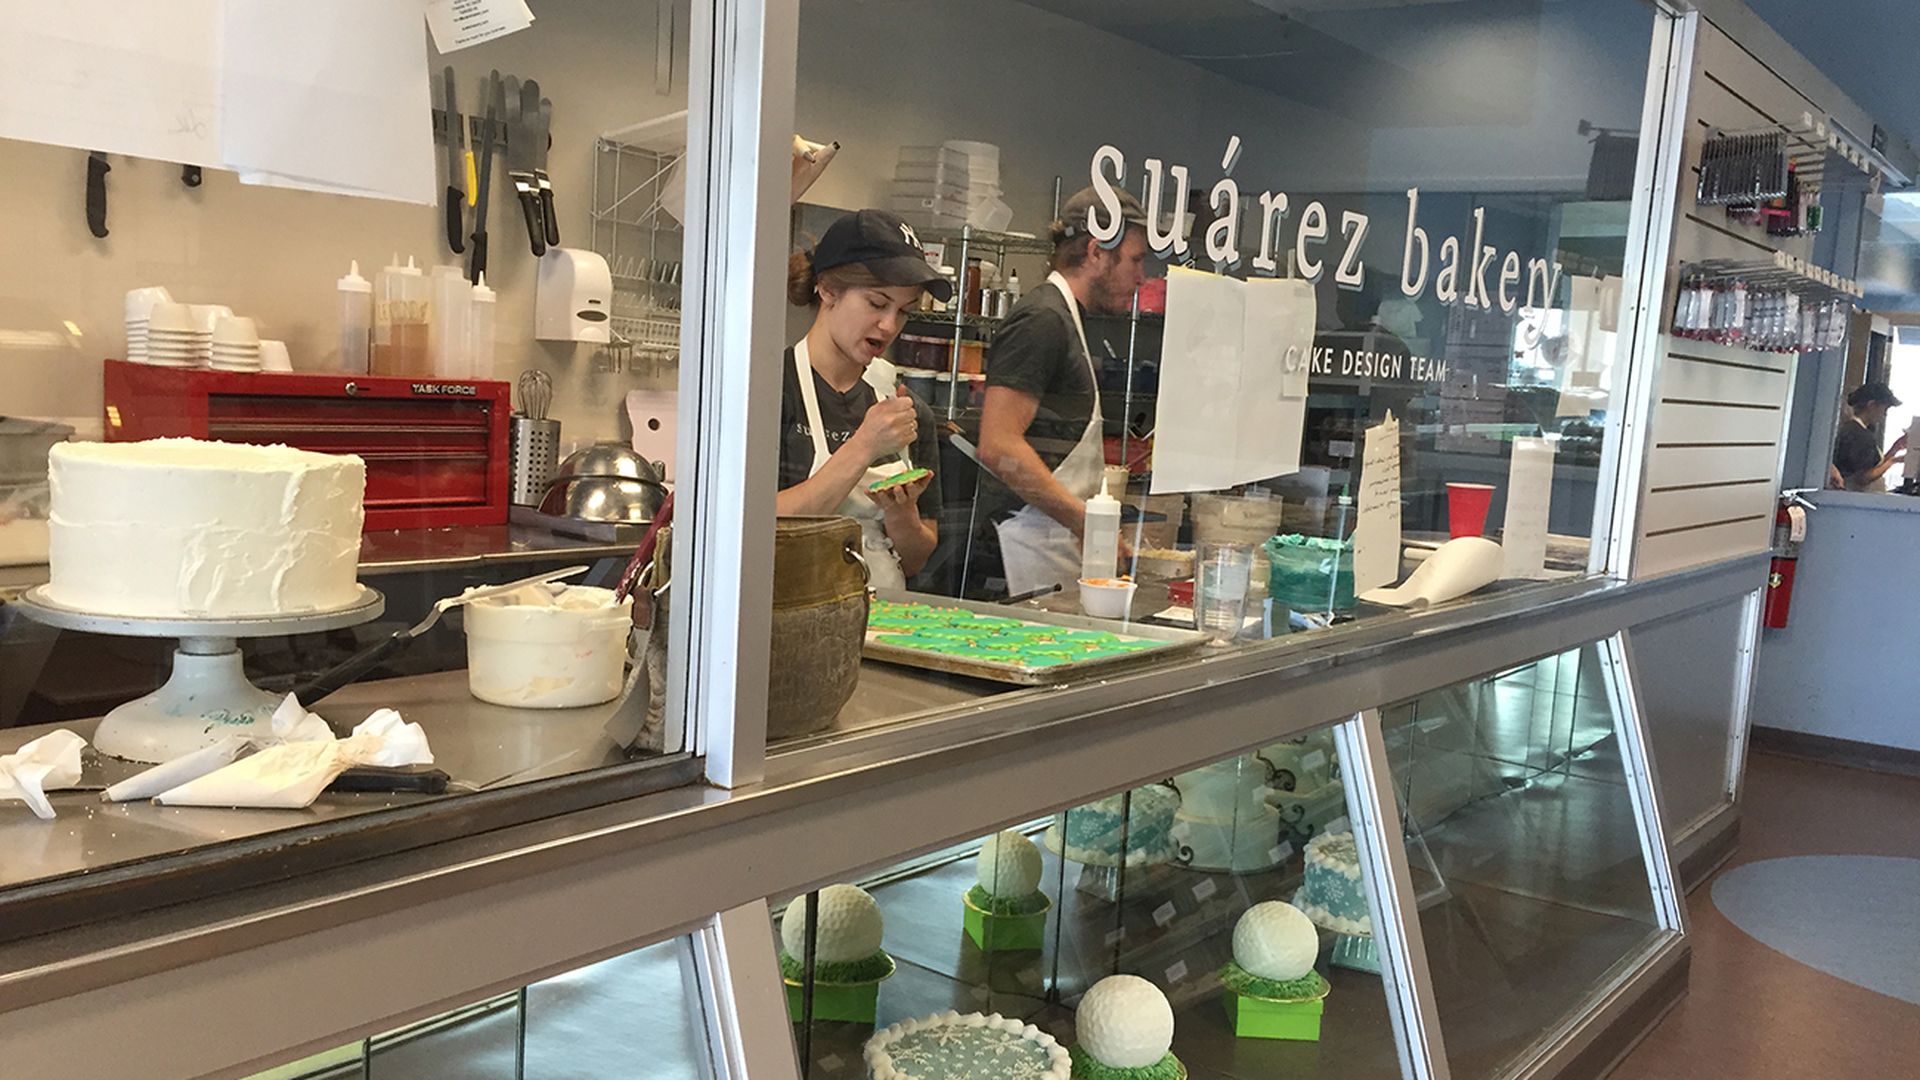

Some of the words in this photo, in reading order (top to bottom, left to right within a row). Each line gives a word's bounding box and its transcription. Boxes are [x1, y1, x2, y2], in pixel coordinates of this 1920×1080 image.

[1401, 187, 1562, 350] bakery
[1285, 345, 1333, 374] CAKE
[1341, 350, 1402, 378] DESIGN
[1410, 356, 1447, 382] TEAM
[412, 383, 440, 394] TASK
[441, 385, 476, 395] FORCE
